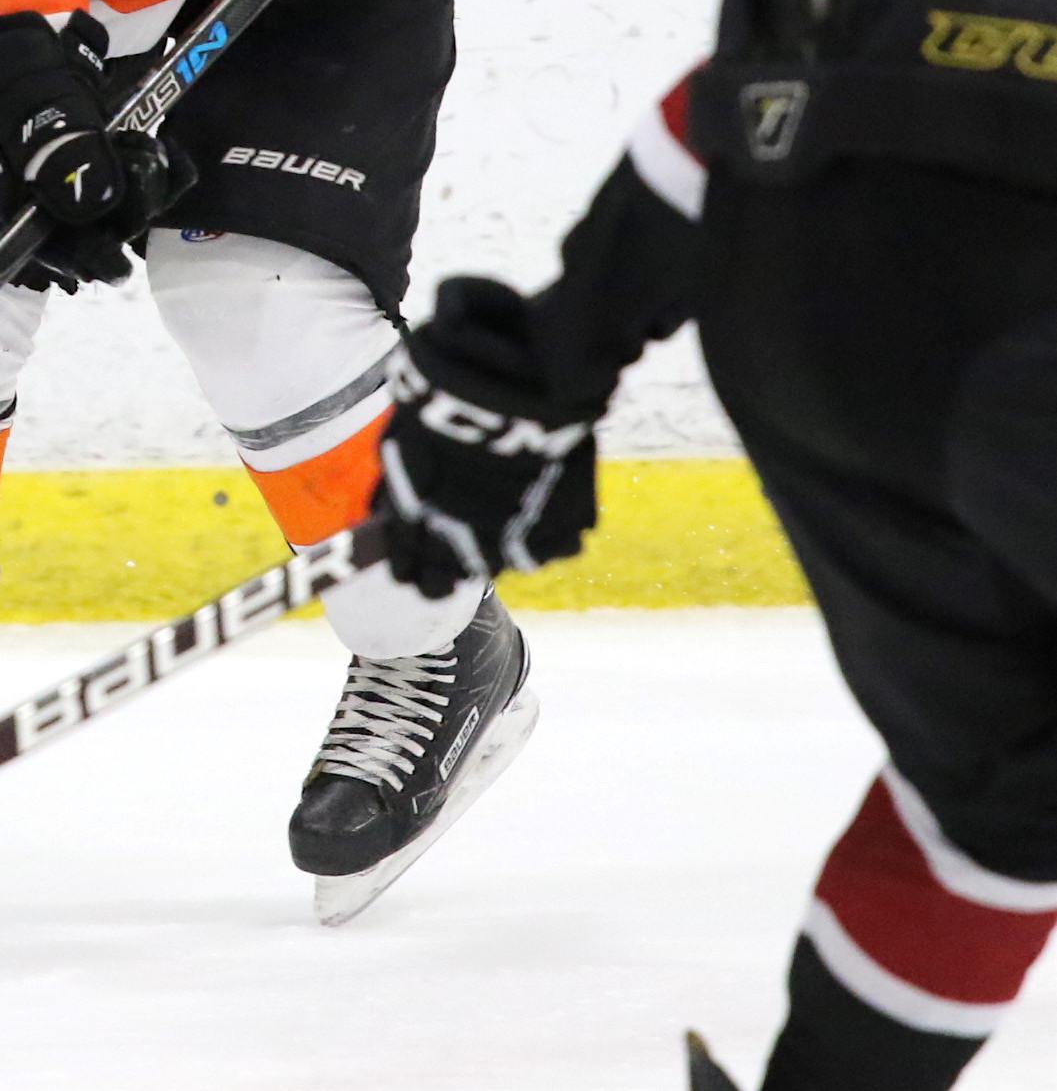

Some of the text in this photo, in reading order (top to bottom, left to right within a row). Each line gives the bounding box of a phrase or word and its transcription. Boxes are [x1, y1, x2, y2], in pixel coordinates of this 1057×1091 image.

[221, 147, 366, 191] BAUER
[13, 529, 358, 757] BAUER
[444, 713, 477, 771] BAUER
